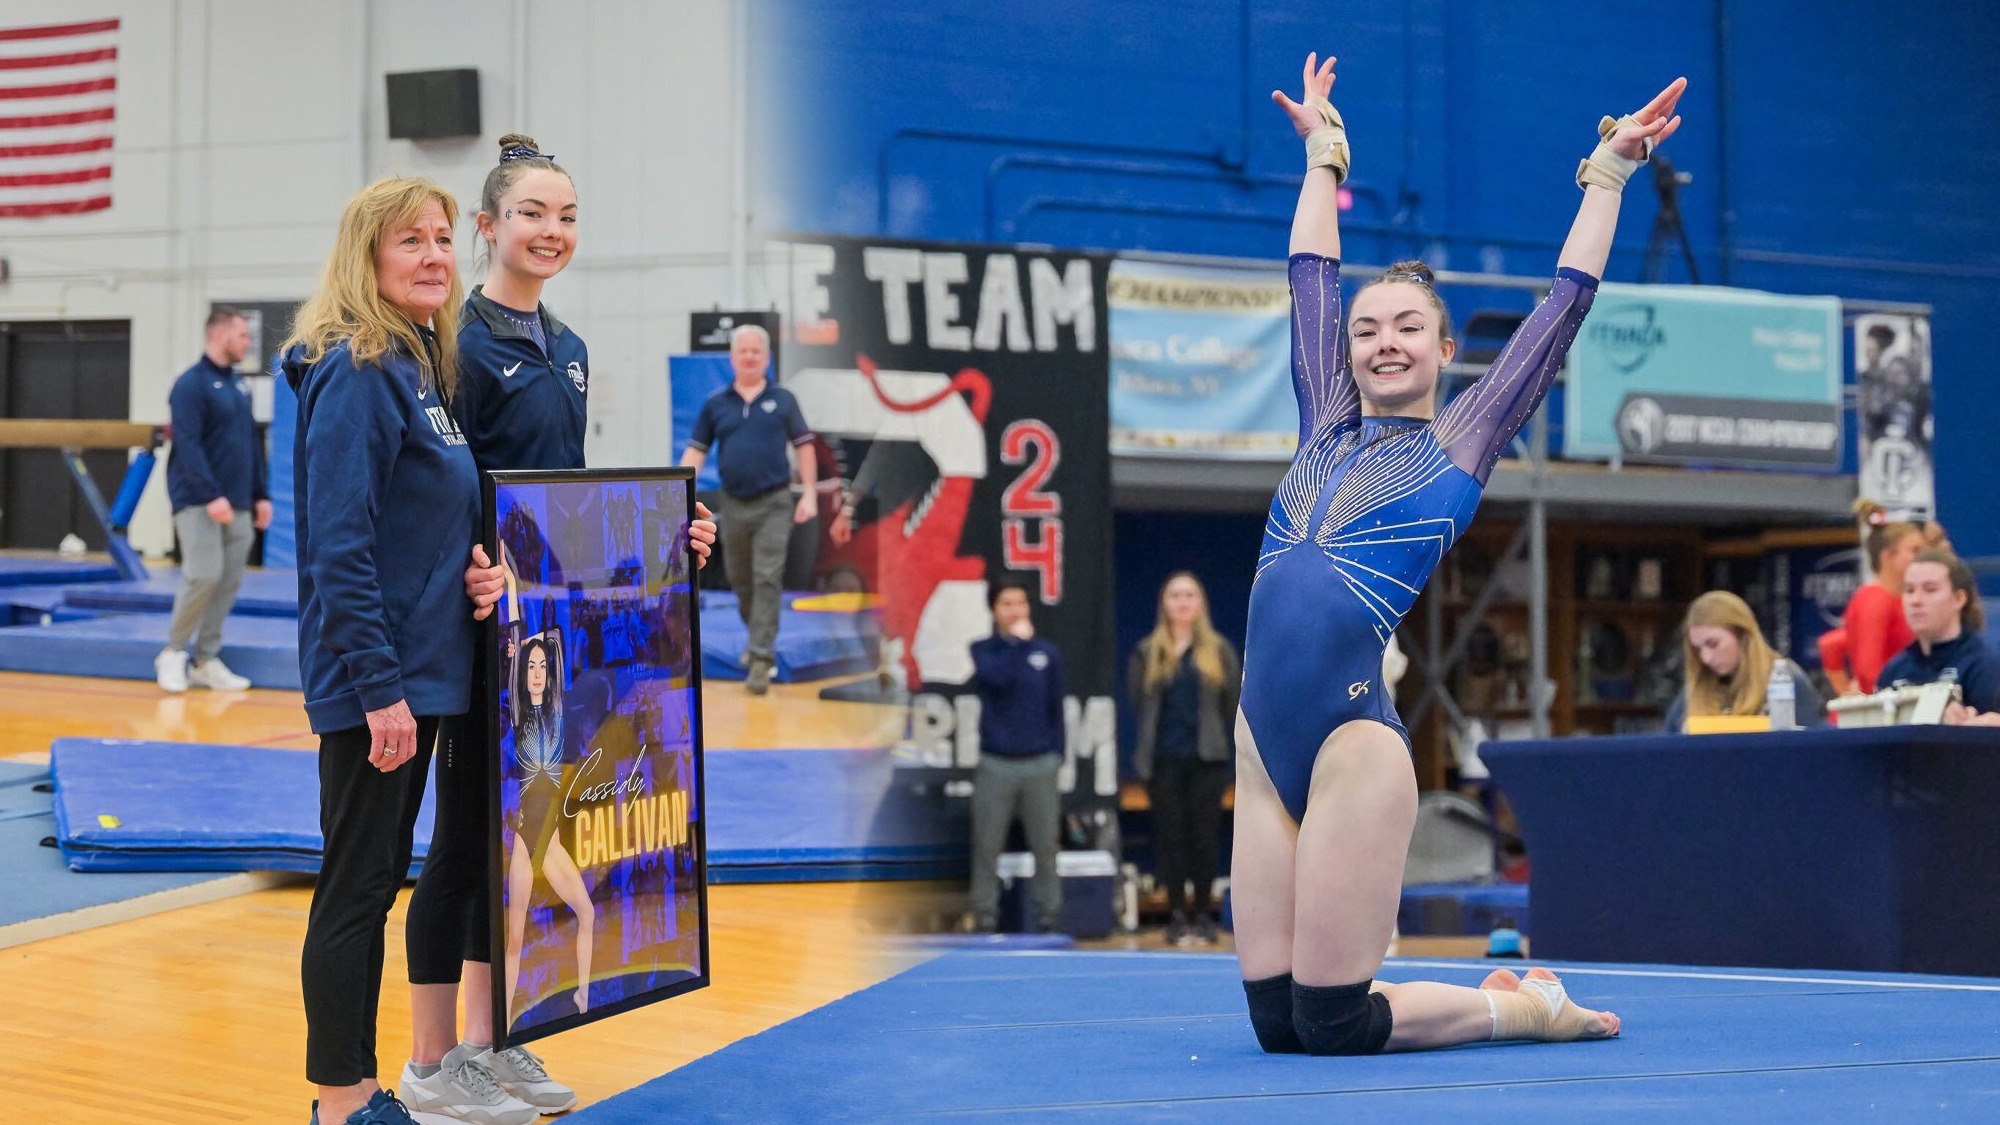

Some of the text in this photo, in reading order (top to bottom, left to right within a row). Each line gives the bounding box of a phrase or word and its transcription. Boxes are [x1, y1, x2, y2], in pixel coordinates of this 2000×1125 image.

[863, 247, 1096, 351] TEAM
[563, 744, 647, 818] Cassidy
[575, 790, 687, 868] GALLIVAN
